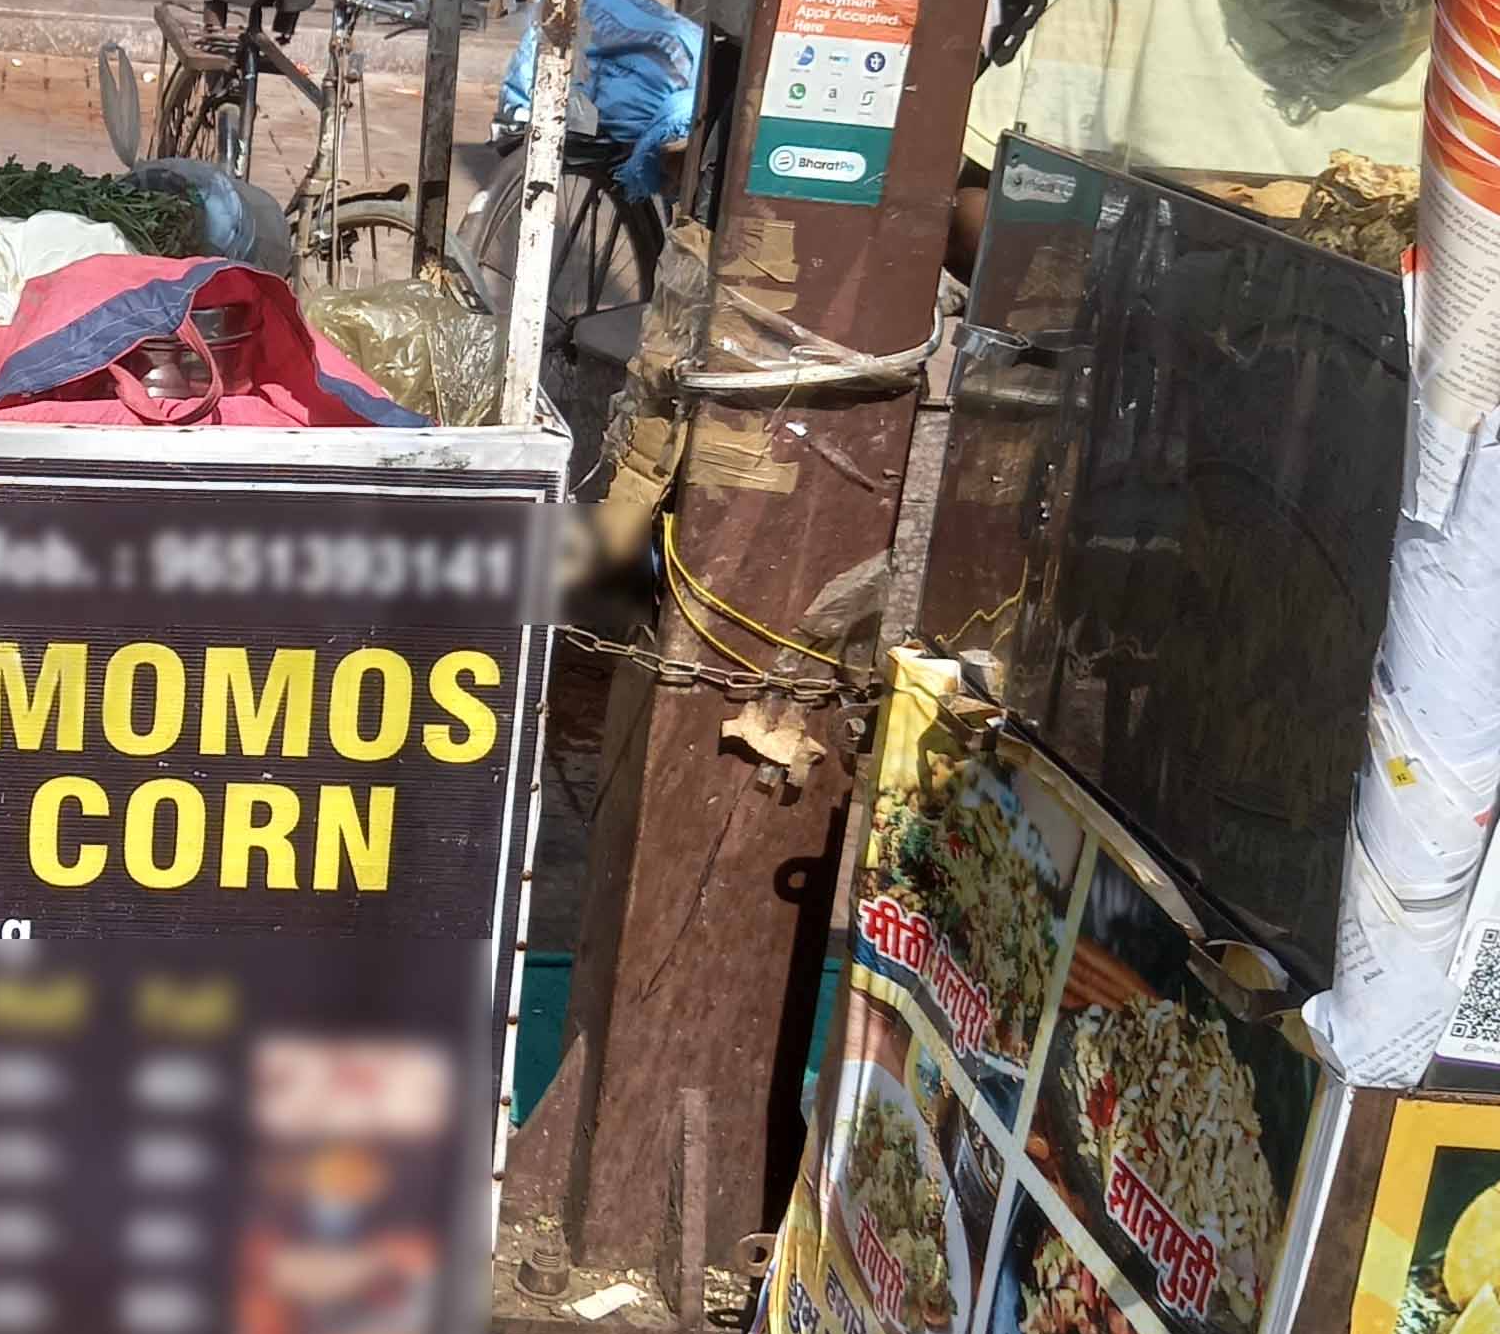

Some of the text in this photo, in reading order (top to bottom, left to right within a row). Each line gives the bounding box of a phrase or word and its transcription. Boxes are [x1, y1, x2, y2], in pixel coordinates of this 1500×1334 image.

[794, 18, 826, 33] Here
[796, 3, 902, 26] Apps Accepted
[798, 156, 855, 172] BharatPe
[28, 775, 396, 892] CORN
[860, 900, 935, 974] मीठी
